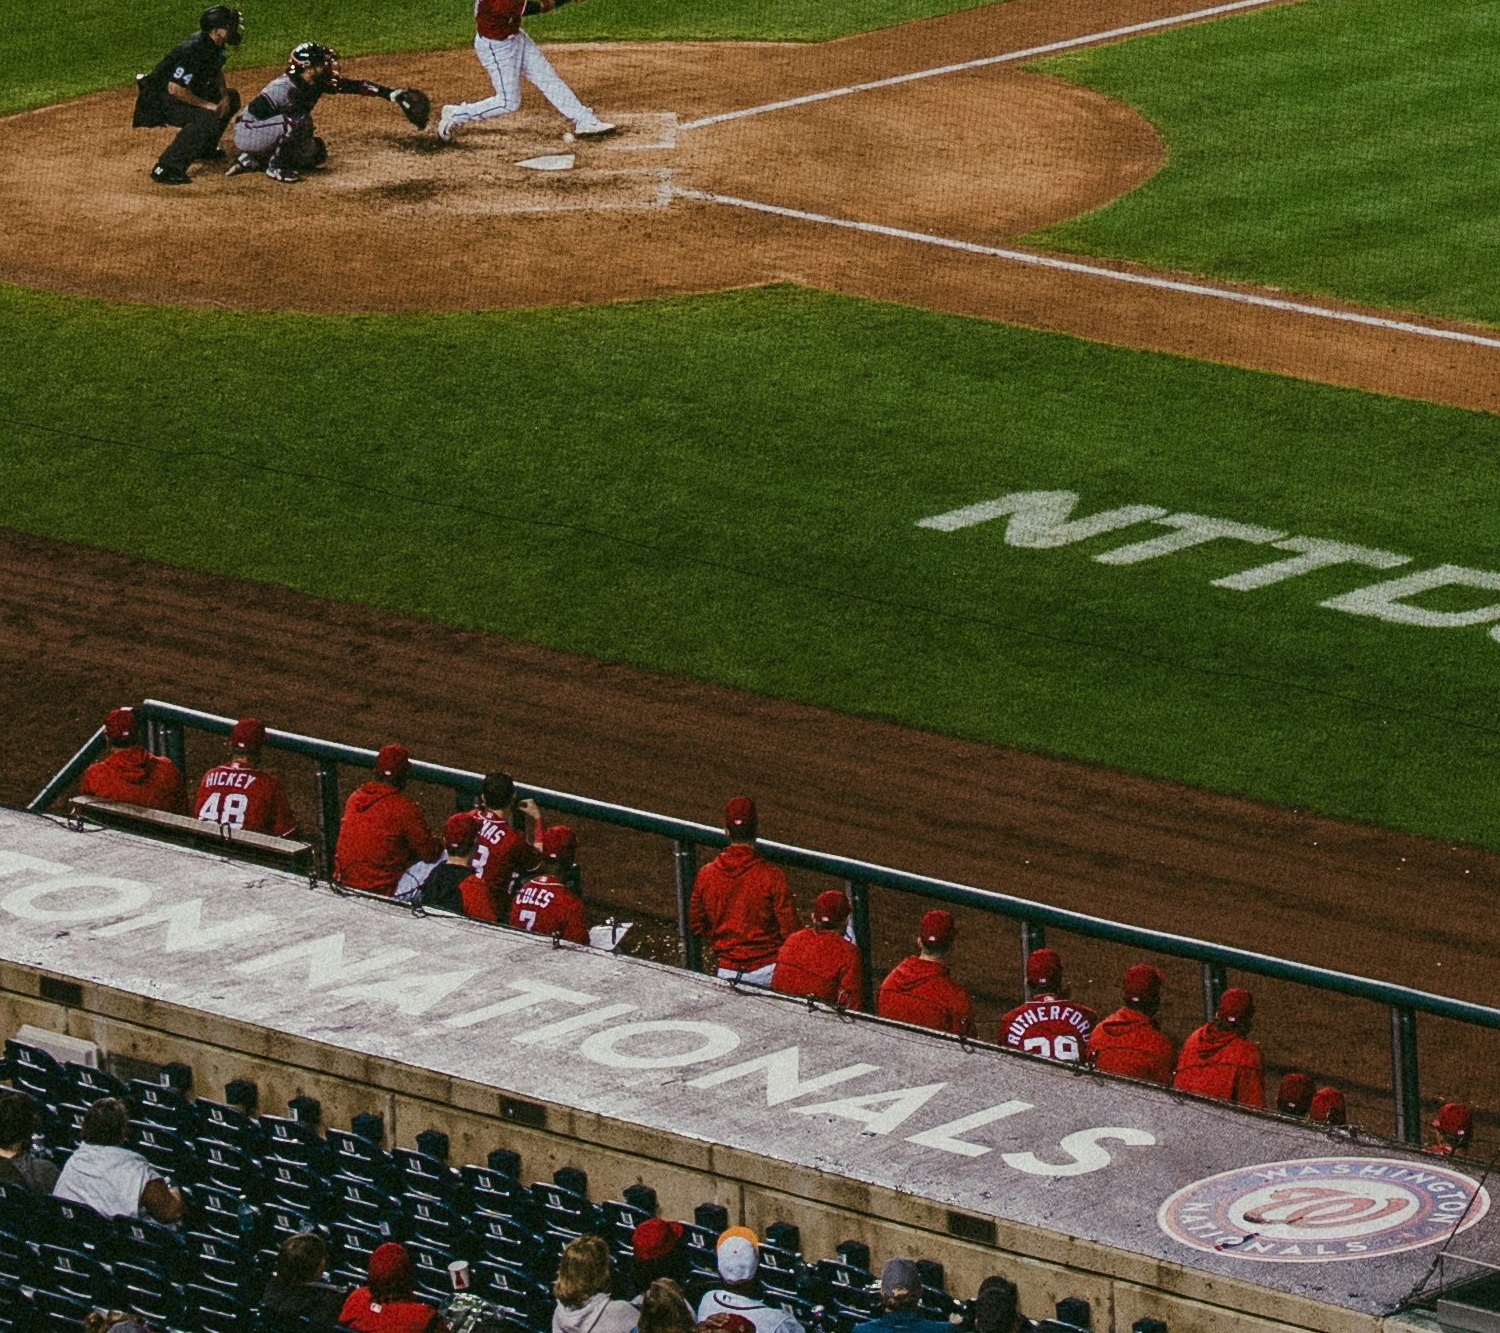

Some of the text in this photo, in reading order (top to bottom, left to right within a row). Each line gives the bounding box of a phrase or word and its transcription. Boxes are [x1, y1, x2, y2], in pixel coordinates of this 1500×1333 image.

[173, 66, 195, 86] 94
[206, 770, 258, 792] HICKEY
[198, 792, 250, 830] 48
[518, 910, 538, 933] 7
[235, 930, 1159, 1179] NATIONALS
[1253, 1162, 1468, 1225] WASHINGTON
